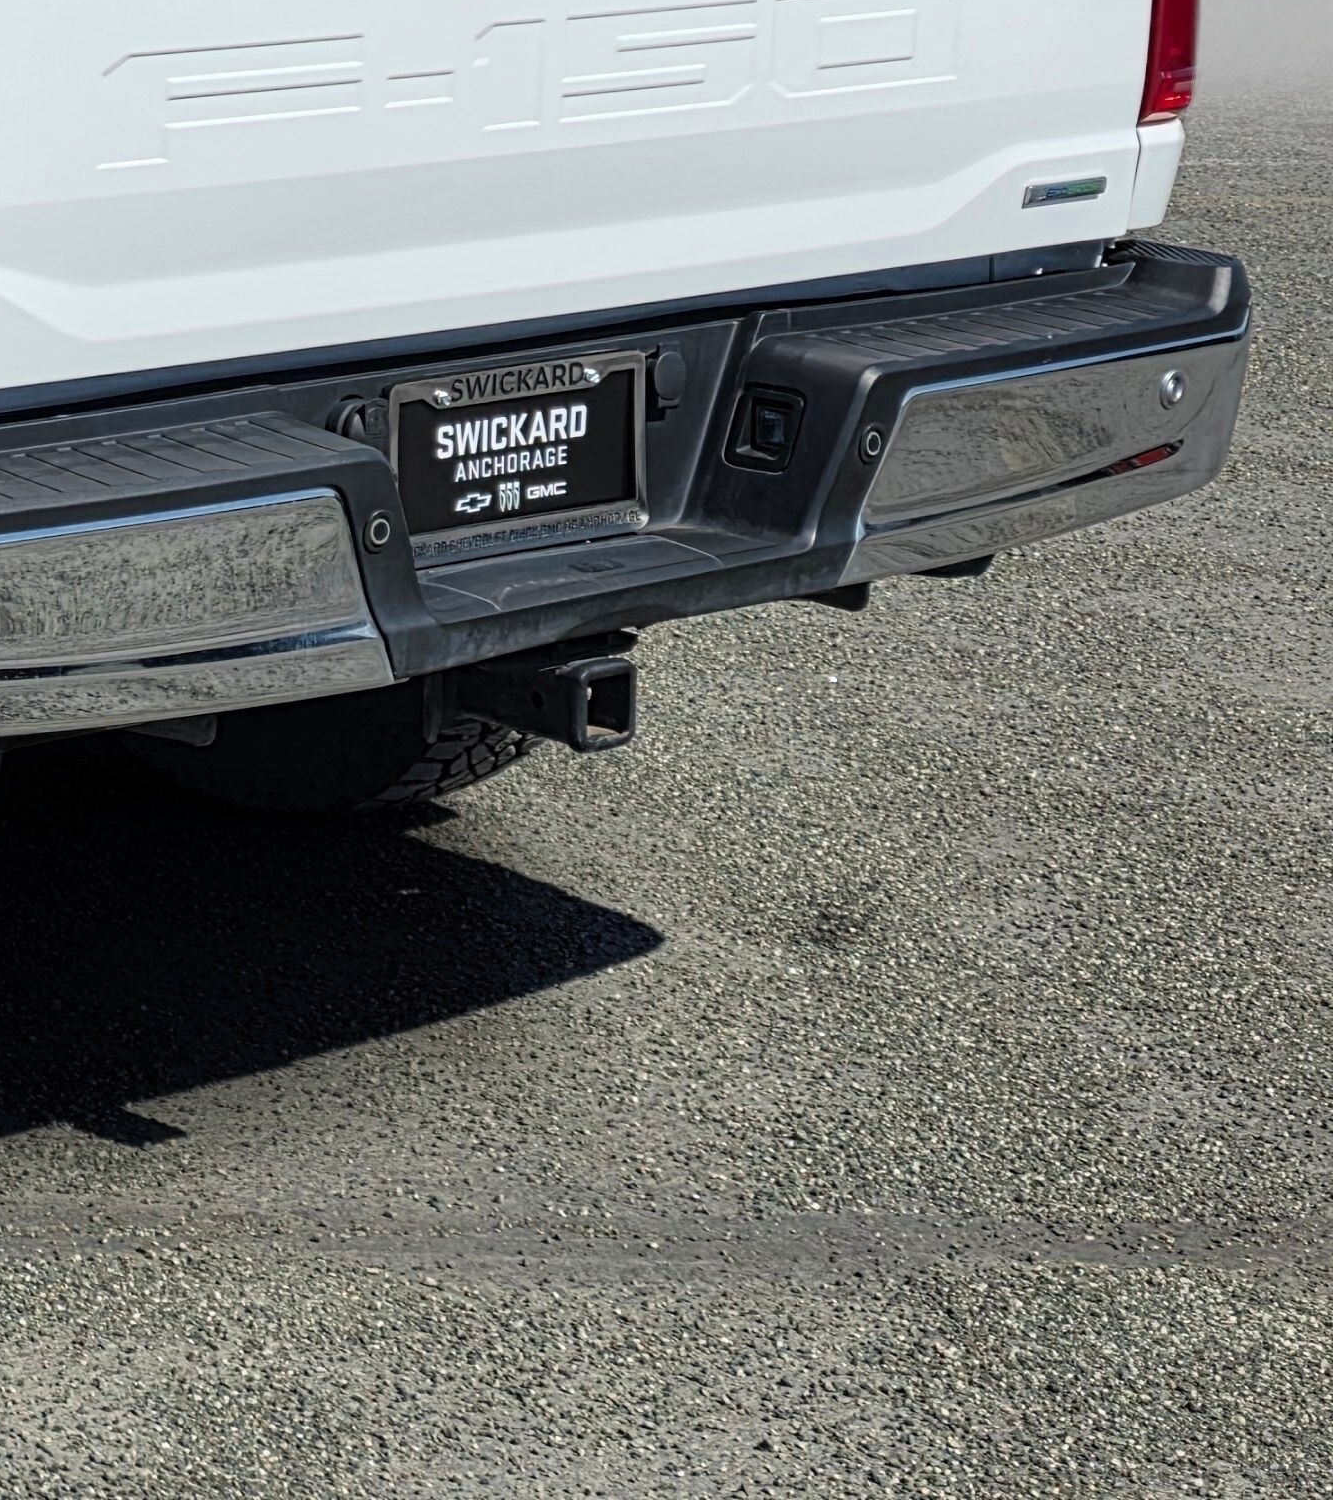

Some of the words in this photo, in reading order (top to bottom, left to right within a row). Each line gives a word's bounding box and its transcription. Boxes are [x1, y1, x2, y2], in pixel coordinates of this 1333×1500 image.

[450, 361, 584, 401] SWICKARD
[436, 404, 587, 459] SWICKARD
[454, 446, 568, 483] ANCHORAGE
[527, 481, 567, 500] GMC
